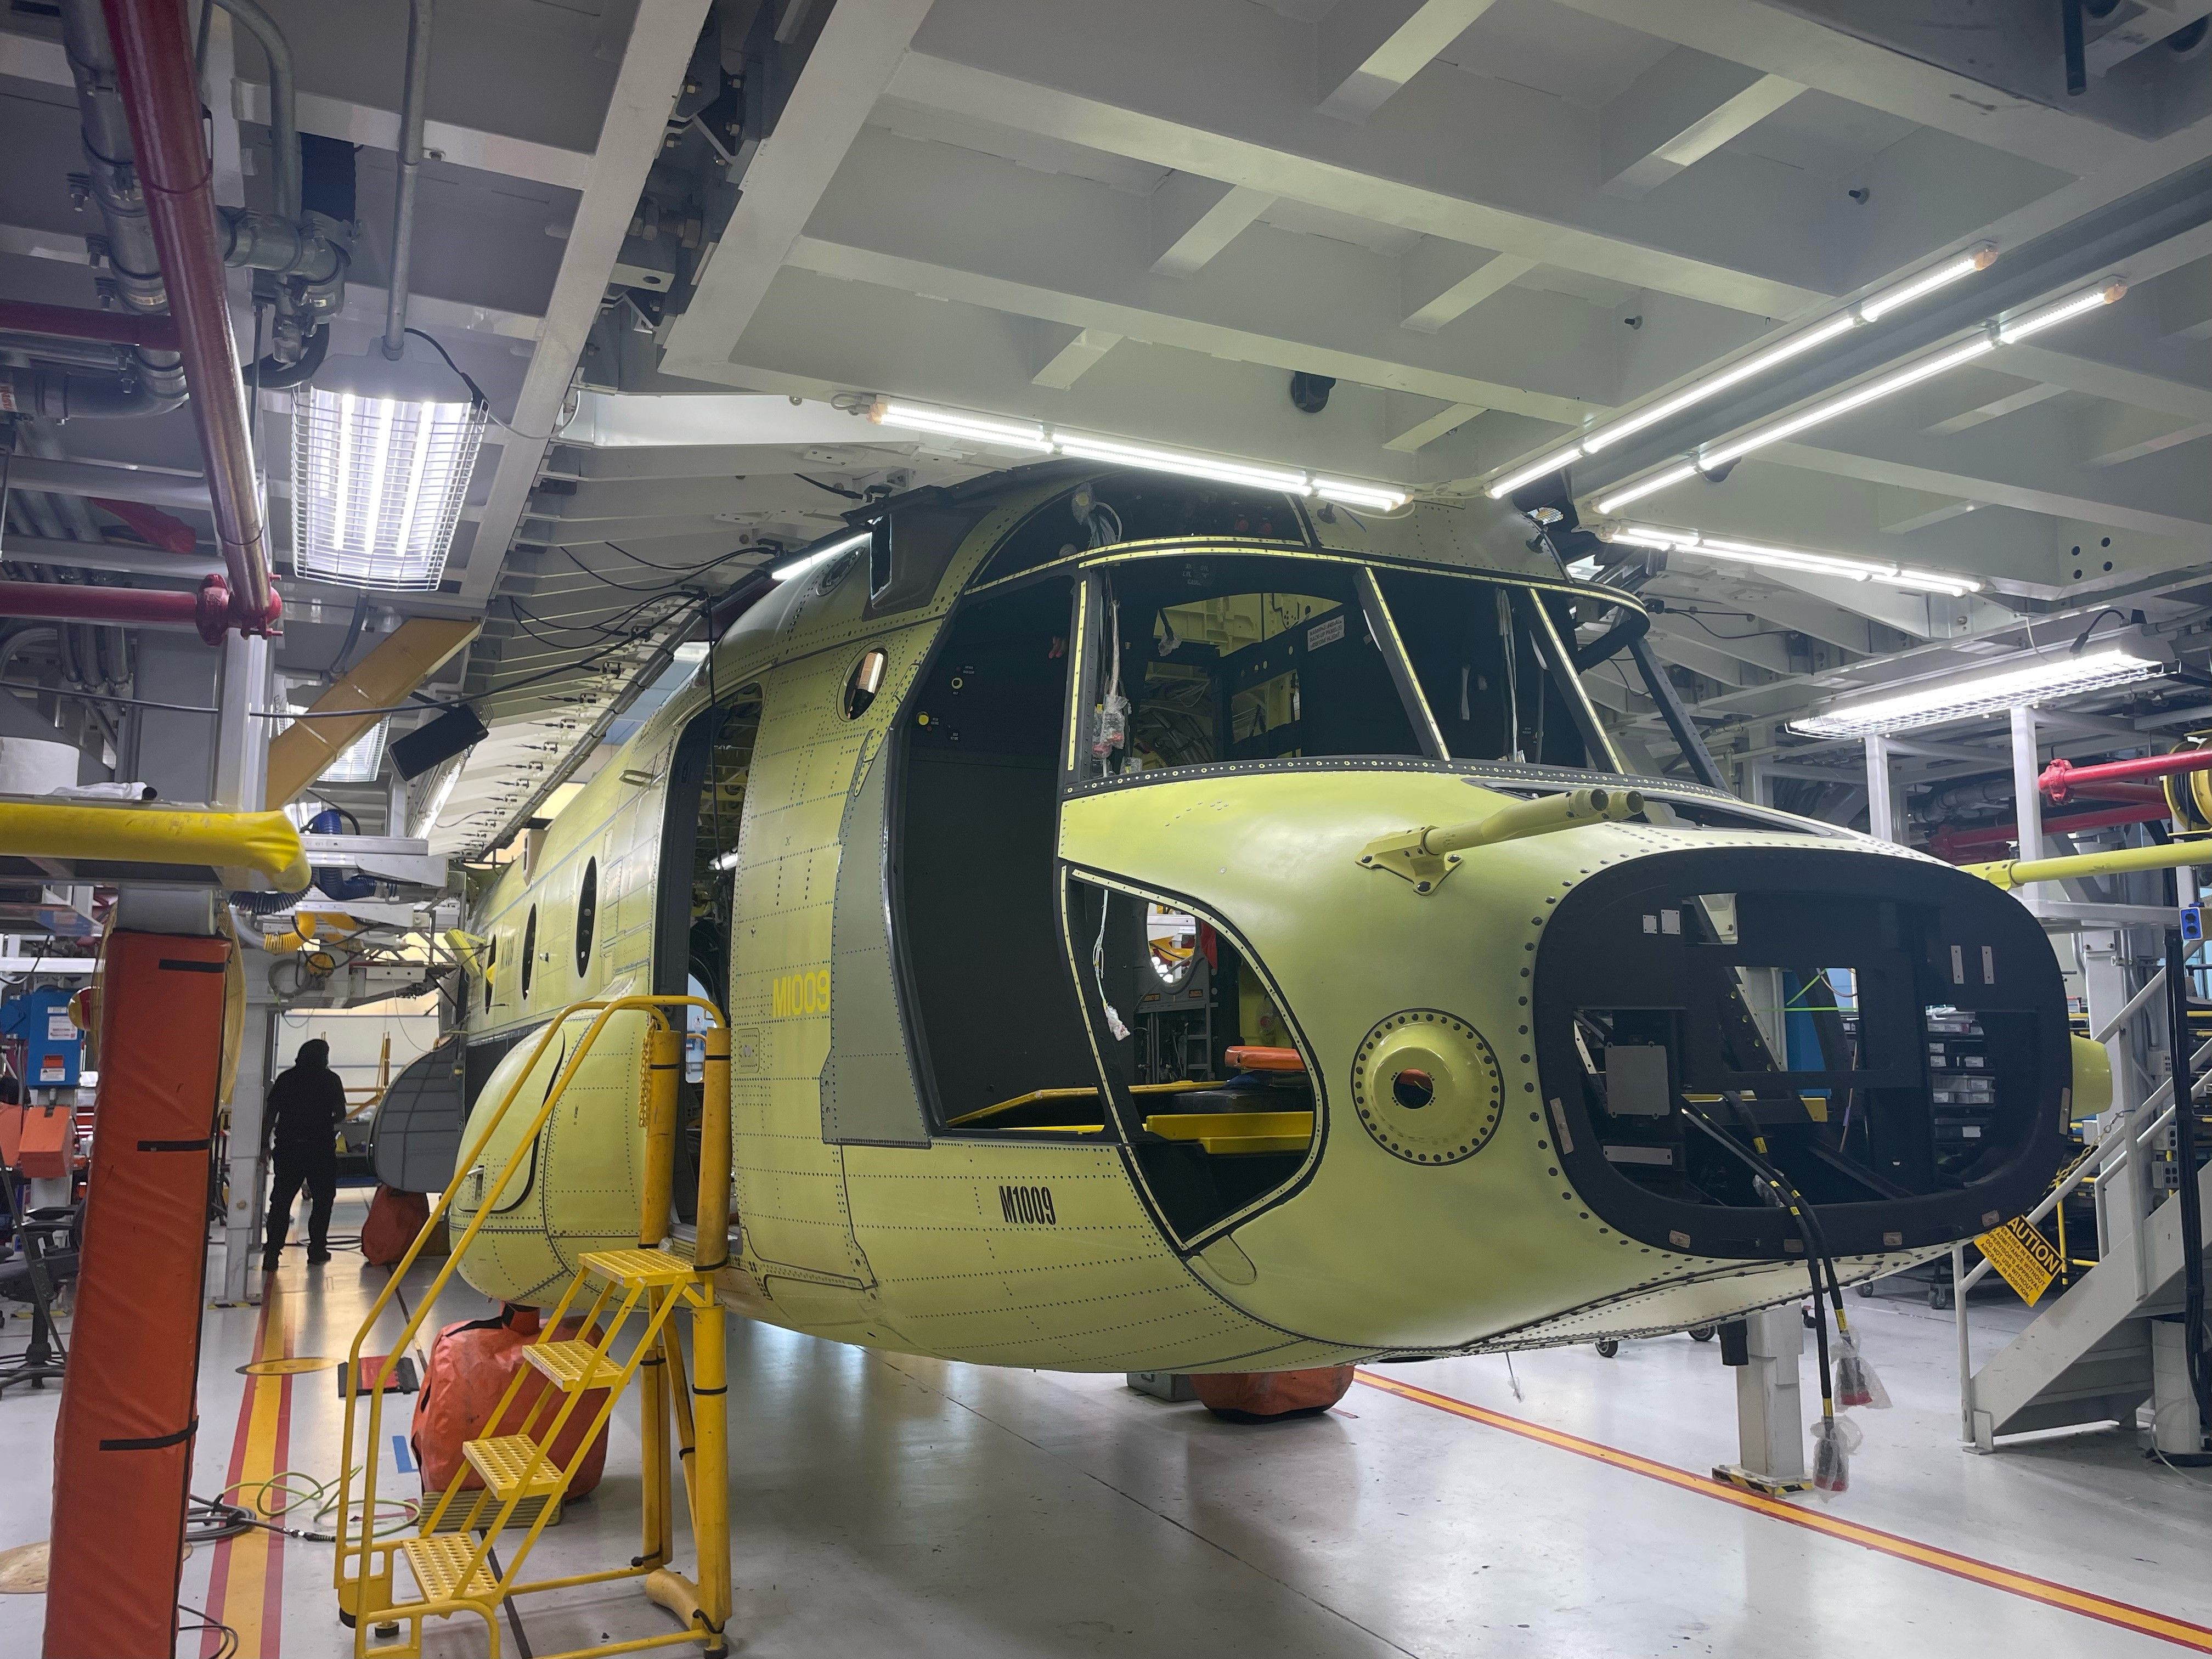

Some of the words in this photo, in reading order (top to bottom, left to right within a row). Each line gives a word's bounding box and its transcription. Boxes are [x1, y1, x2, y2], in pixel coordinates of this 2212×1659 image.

[998, 1186, 1056, 1225] M1009
[1980, 1242, 2002, 1268] AIRCRAFT
[1987, 1231, 2016, 1264] UPERVISOR'S
[1995, 1231, 2024, 1263] ADMITTANCE
[2023, 1261, 2045, 1286] WITHOUT
[2007, 1234, 2021, 1250] AREA
[2007, 1217, 2059, 1273] AUTION
[1992, 1246, 2002, 1259] NOT
[2011, 1267, 2033, 1293] WITHOUT
